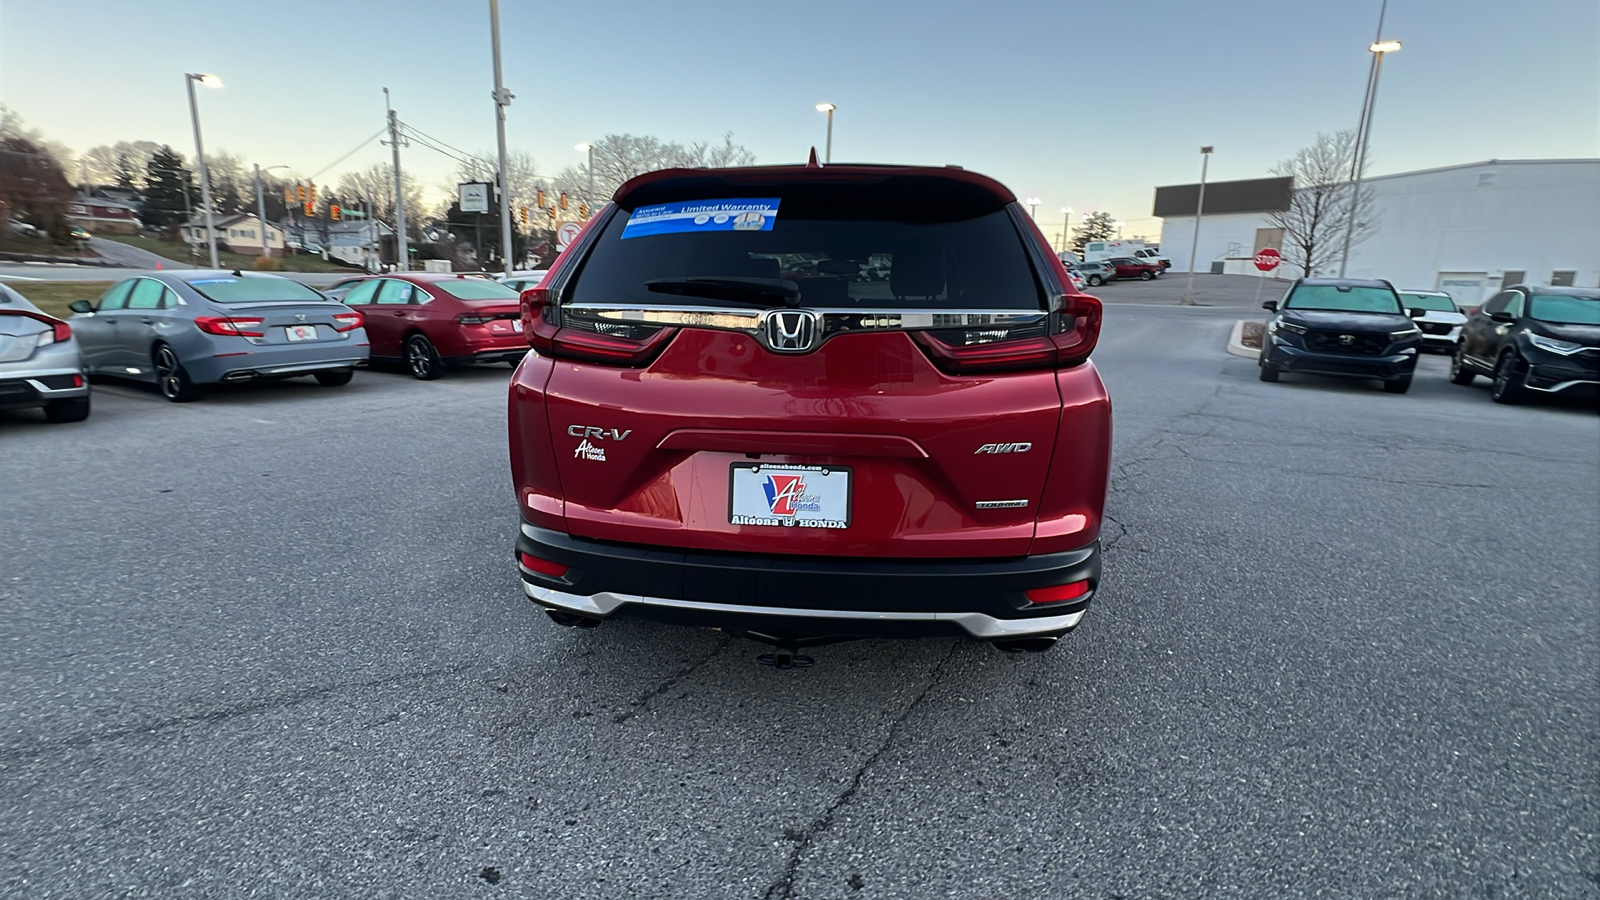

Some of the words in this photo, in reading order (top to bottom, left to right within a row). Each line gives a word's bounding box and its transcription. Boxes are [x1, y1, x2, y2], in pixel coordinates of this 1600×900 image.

[680, 204, 720, 213] Limited
[721, 203, 771, 212] Warranty
[1255, 254, 1279, 265] STOP
[567, 424, 633, 441] CR-V
[974, 442, 1032, 455] AWD
[760, 463, 822, 471] altoonahonda.com
[790, 501, 820, 511] Honda
[731, 515, 779, 526] Altoona
[798, 519, 847, 529] HONDA
